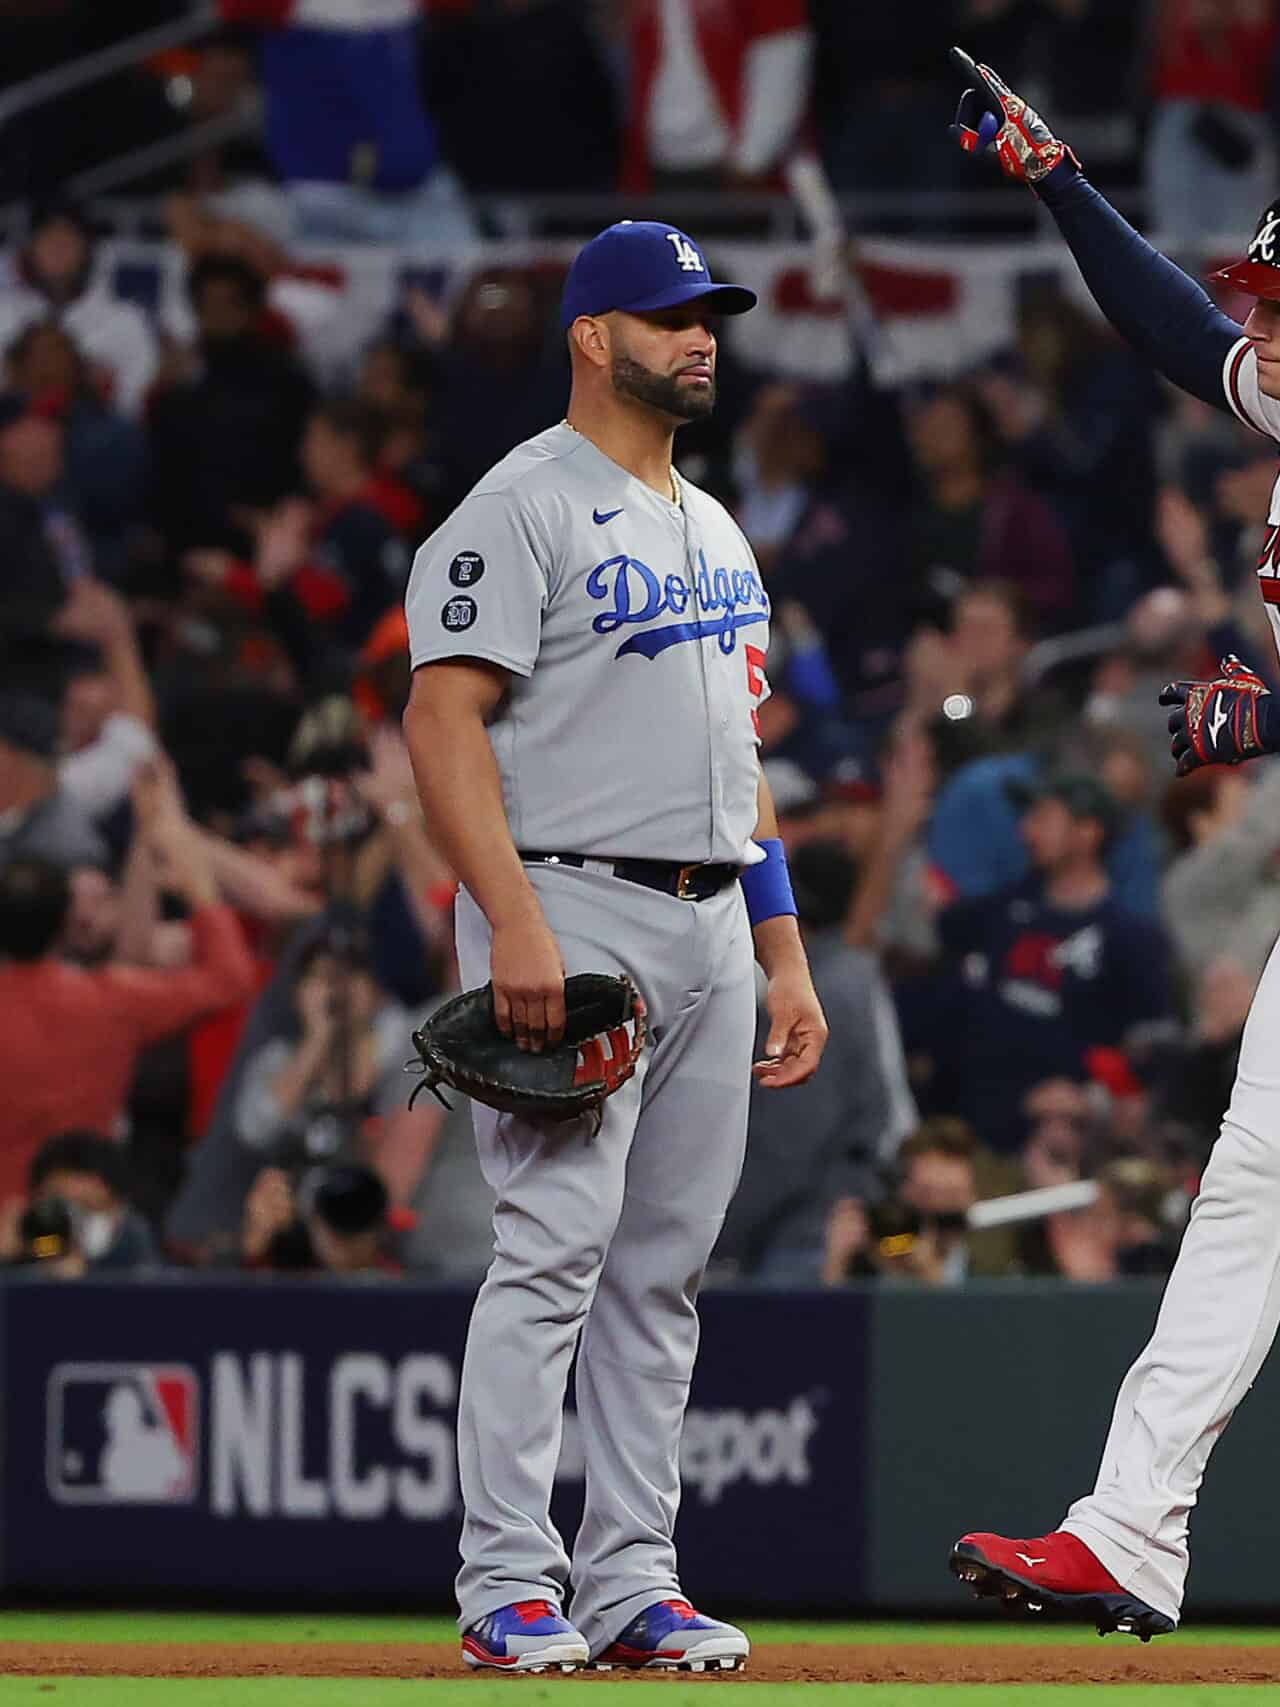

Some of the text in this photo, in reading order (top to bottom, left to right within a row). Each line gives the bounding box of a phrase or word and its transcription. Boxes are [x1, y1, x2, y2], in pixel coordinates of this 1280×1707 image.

[666, 233, 705, 272] LA
[458, 561, 473, 581] 2
[446, 605, 471, 625] 20
[211, 1352, 816, 1519] NLCS epot
